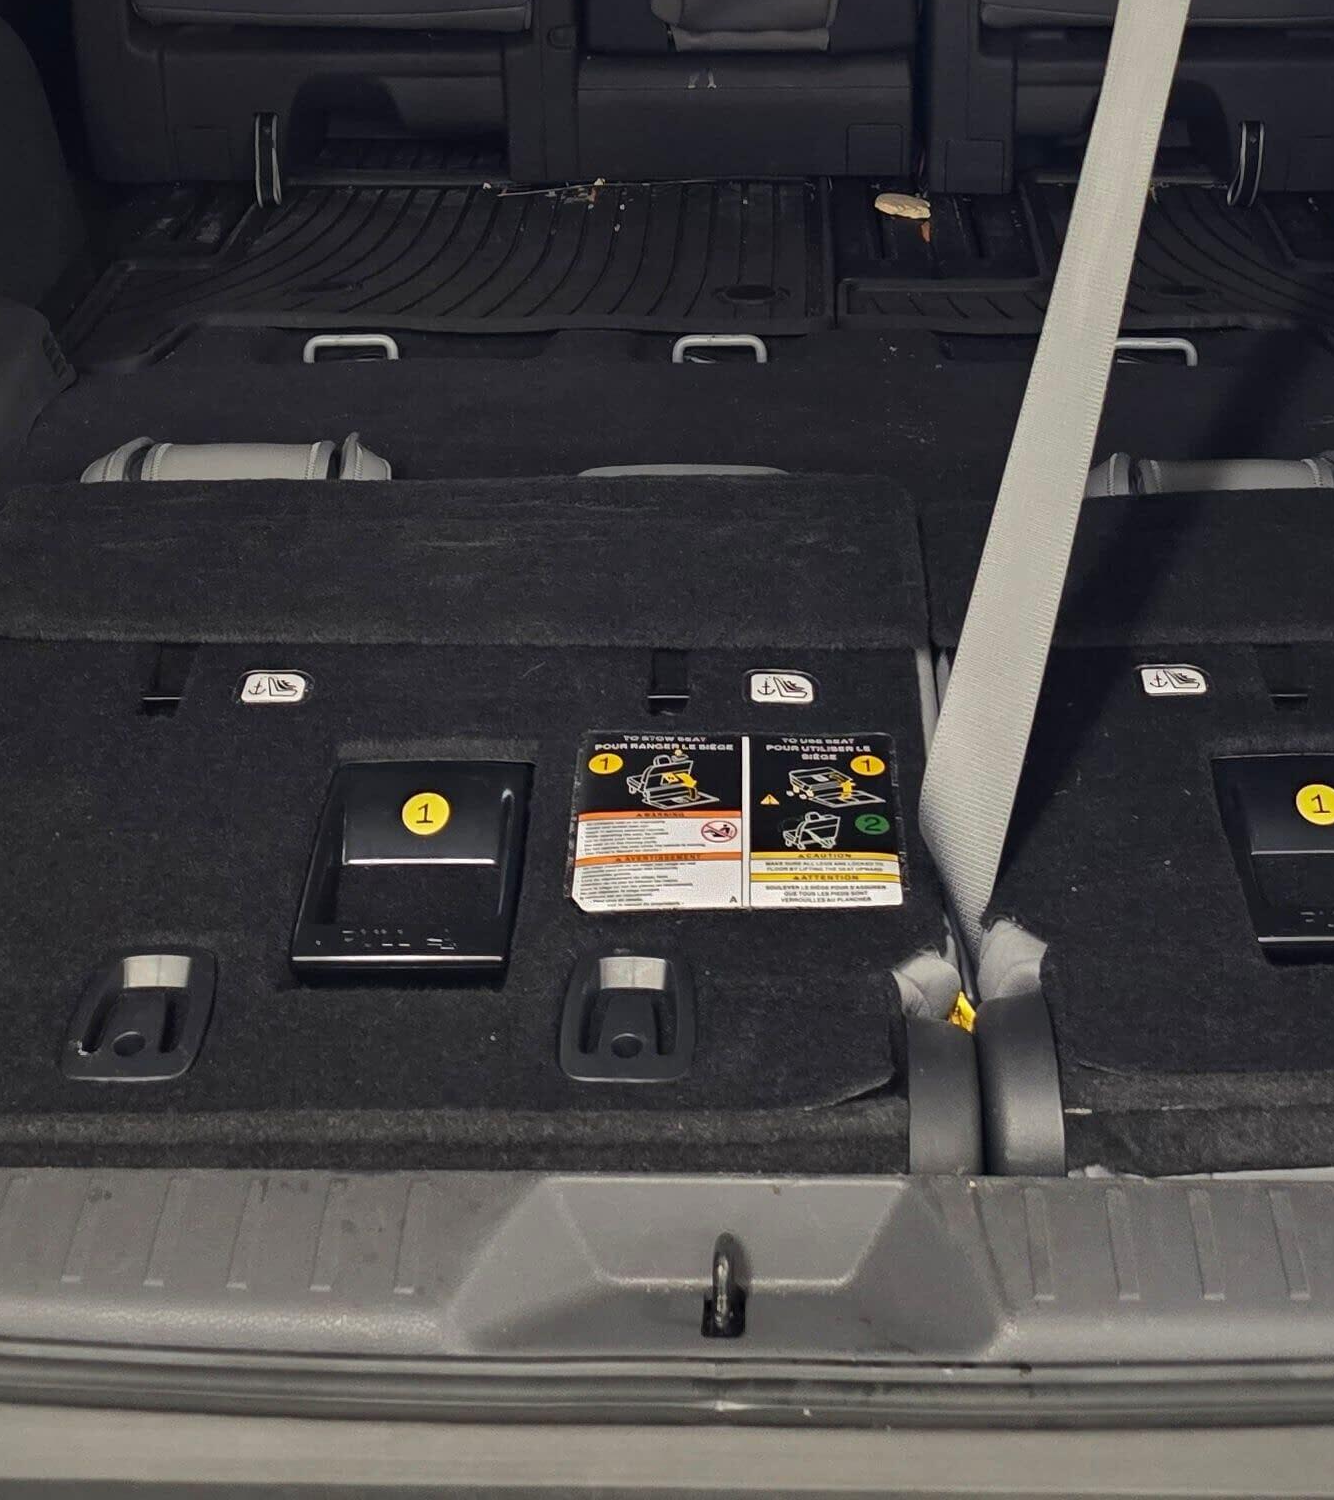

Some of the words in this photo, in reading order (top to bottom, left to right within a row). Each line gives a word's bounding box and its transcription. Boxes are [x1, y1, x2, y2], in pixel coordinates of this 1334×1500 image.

[765, 744, 799, 752] POUR
[599, 756, 609, 770] 1
[860, 760, 871, 772] 1
[1311, 794, 1331, 814] 1
[416, 803, 434, 824] 1
[864, 816, 881, 832] 2
